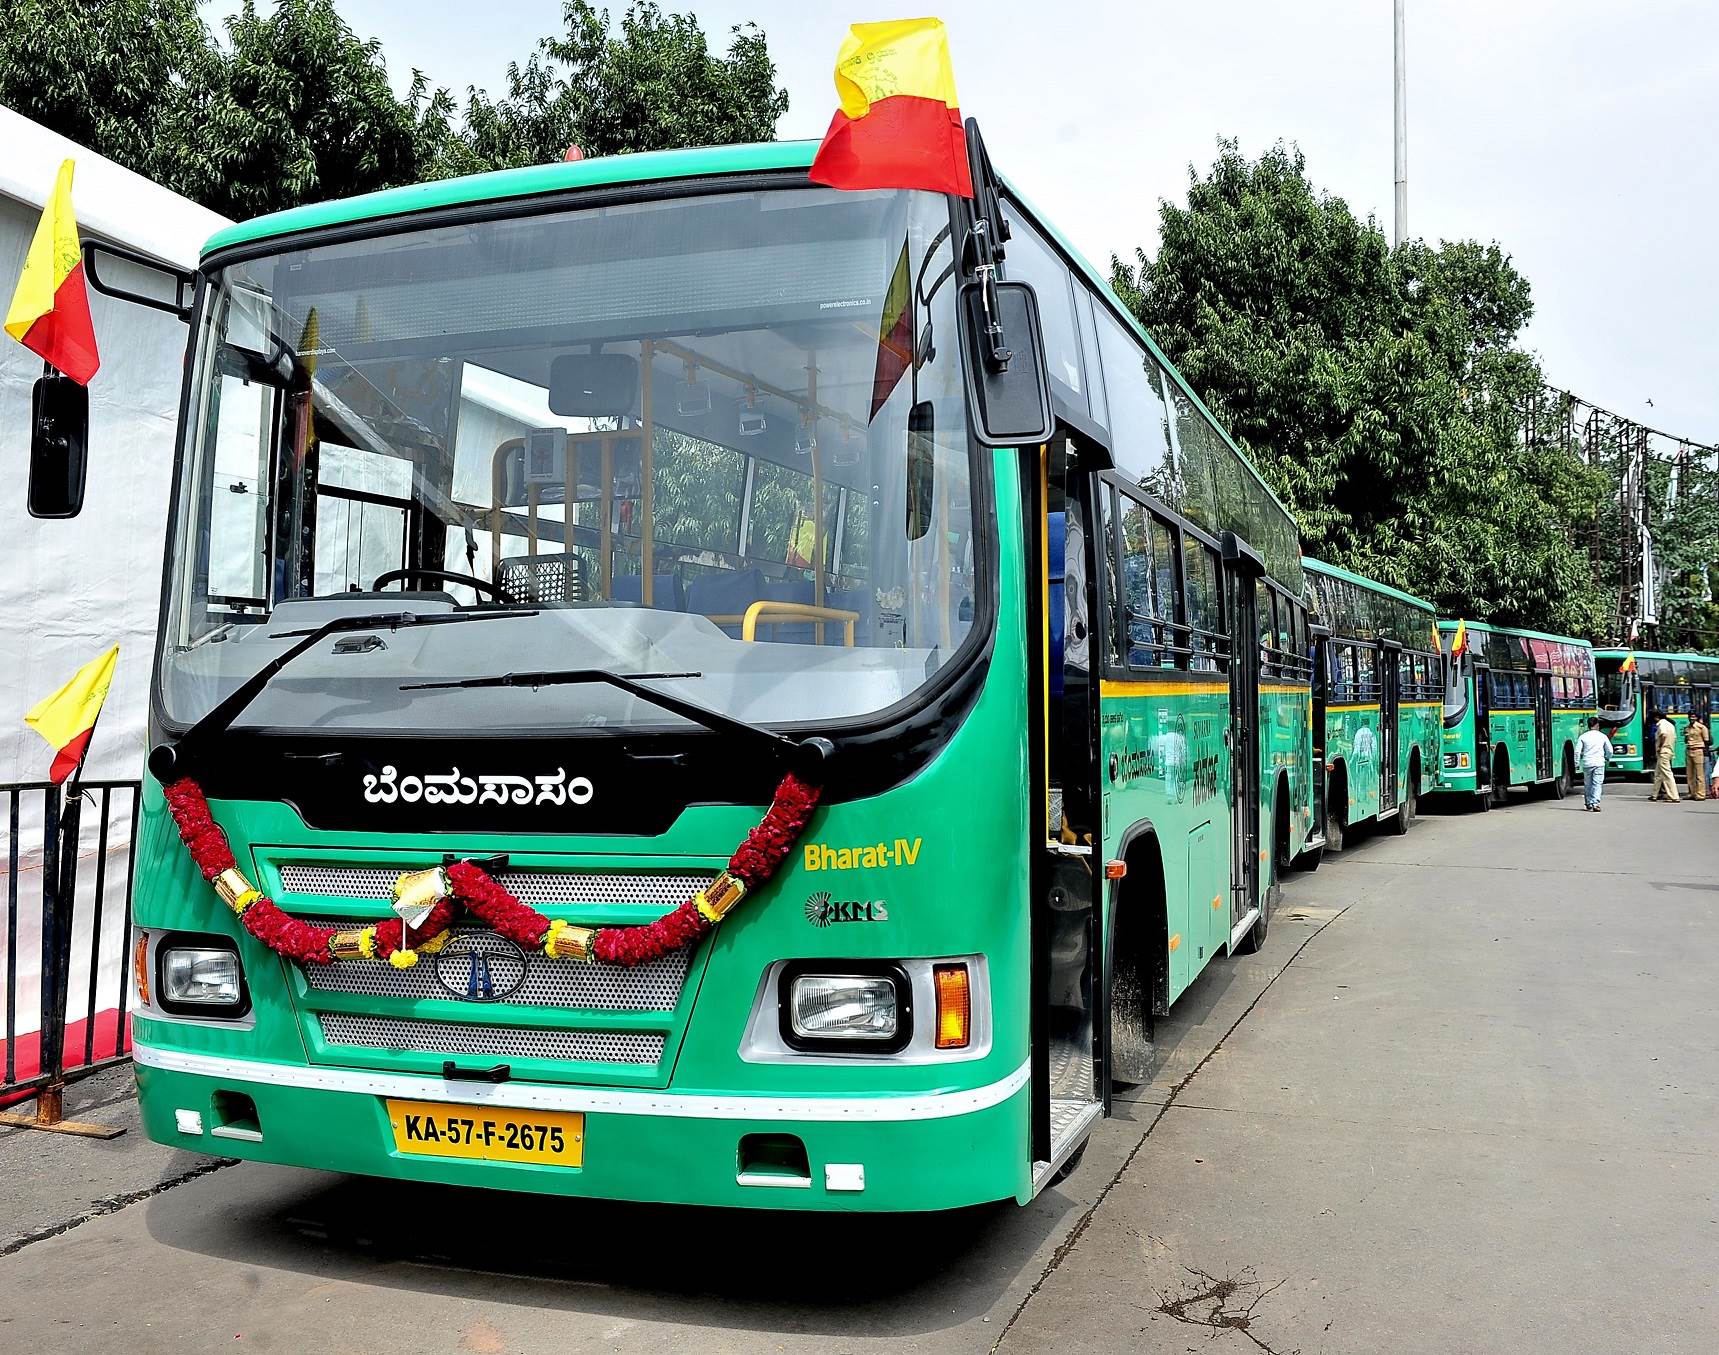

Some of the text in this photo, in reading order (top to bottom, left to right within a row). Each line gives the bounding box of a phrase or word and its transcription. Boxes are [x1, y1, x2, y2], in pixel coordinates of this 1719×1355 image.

[362, 764, 594, 806] ಬೆಂಮಸಾಸಂ
[804, 838, 922, 871] Bharat-IV
[404, 1113, 565, 1154] KA-57-F-2675
